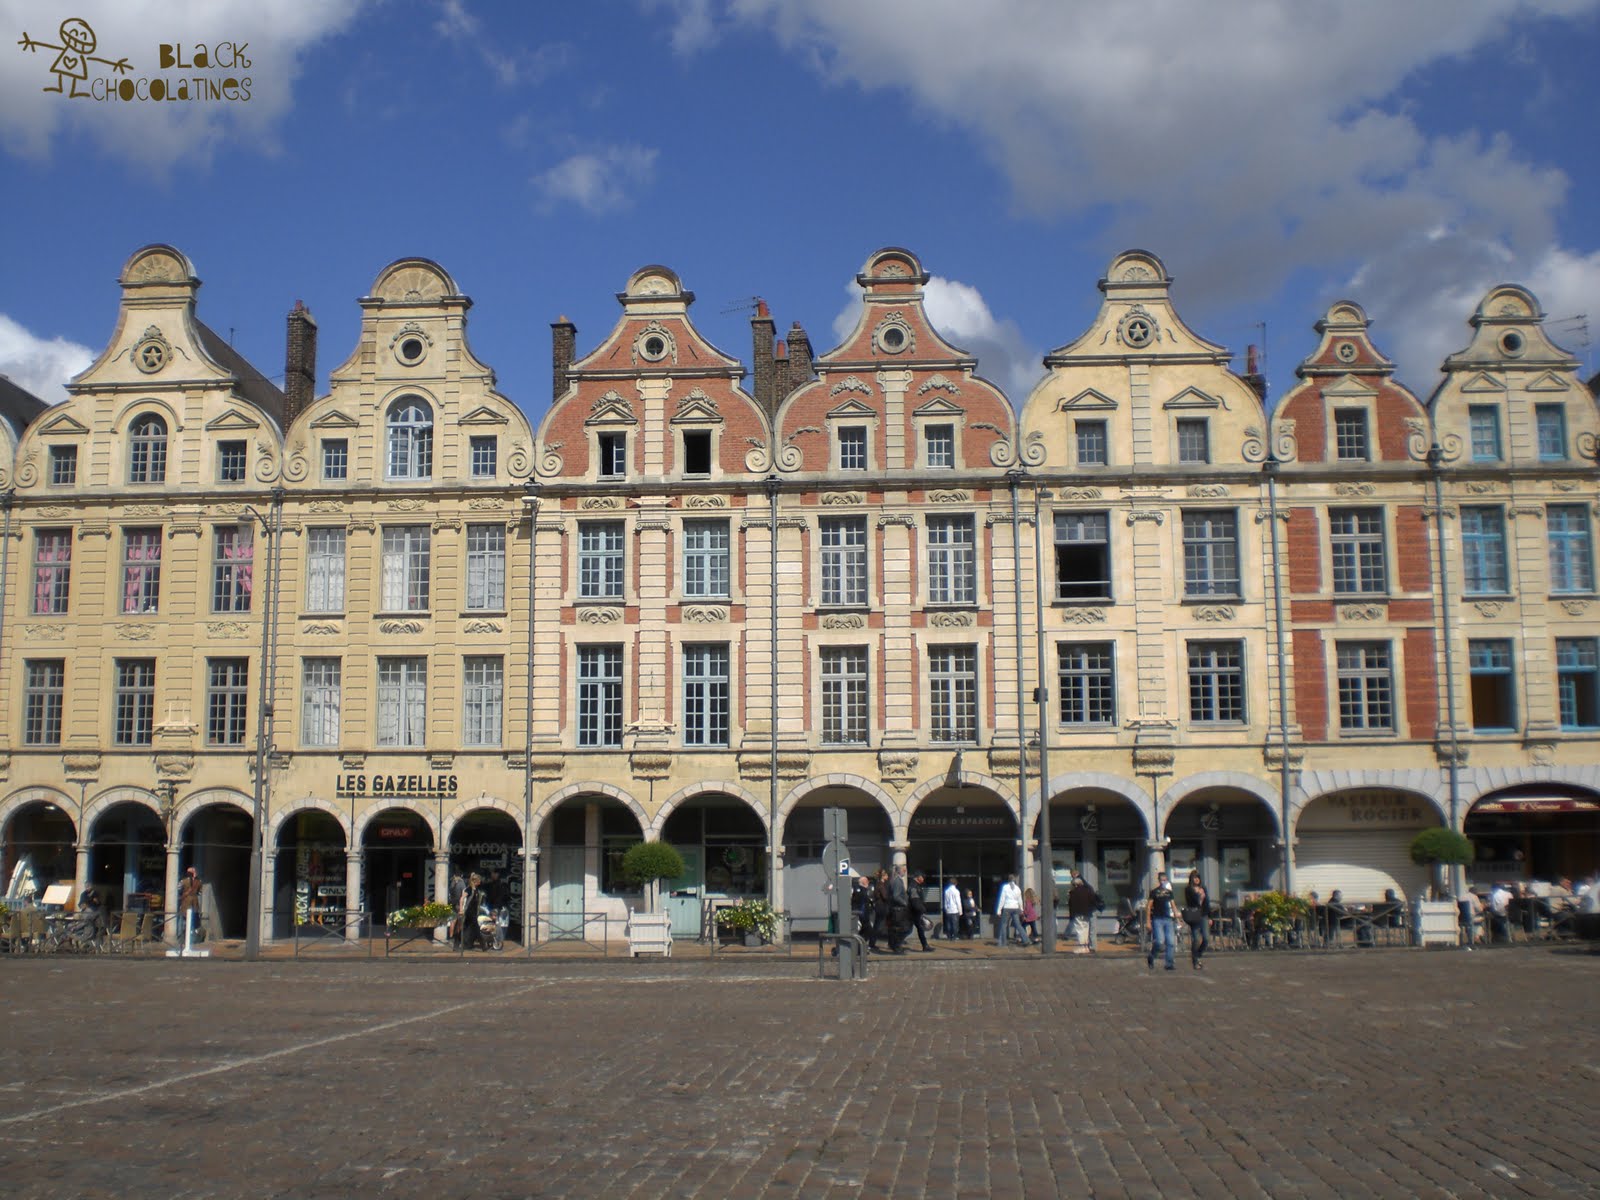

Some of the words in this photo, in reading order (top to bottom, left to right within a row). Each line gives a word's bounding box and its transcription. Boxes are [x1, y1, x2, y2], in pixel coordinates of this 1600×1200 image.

[336, 774, 366, 791] LES
[372, 775, 458, 792] GAZELLES
[914, 817, 947, 826] CAISSE
[467, 842, 509, 855] MODA
[839, 861, 849, 874] P
